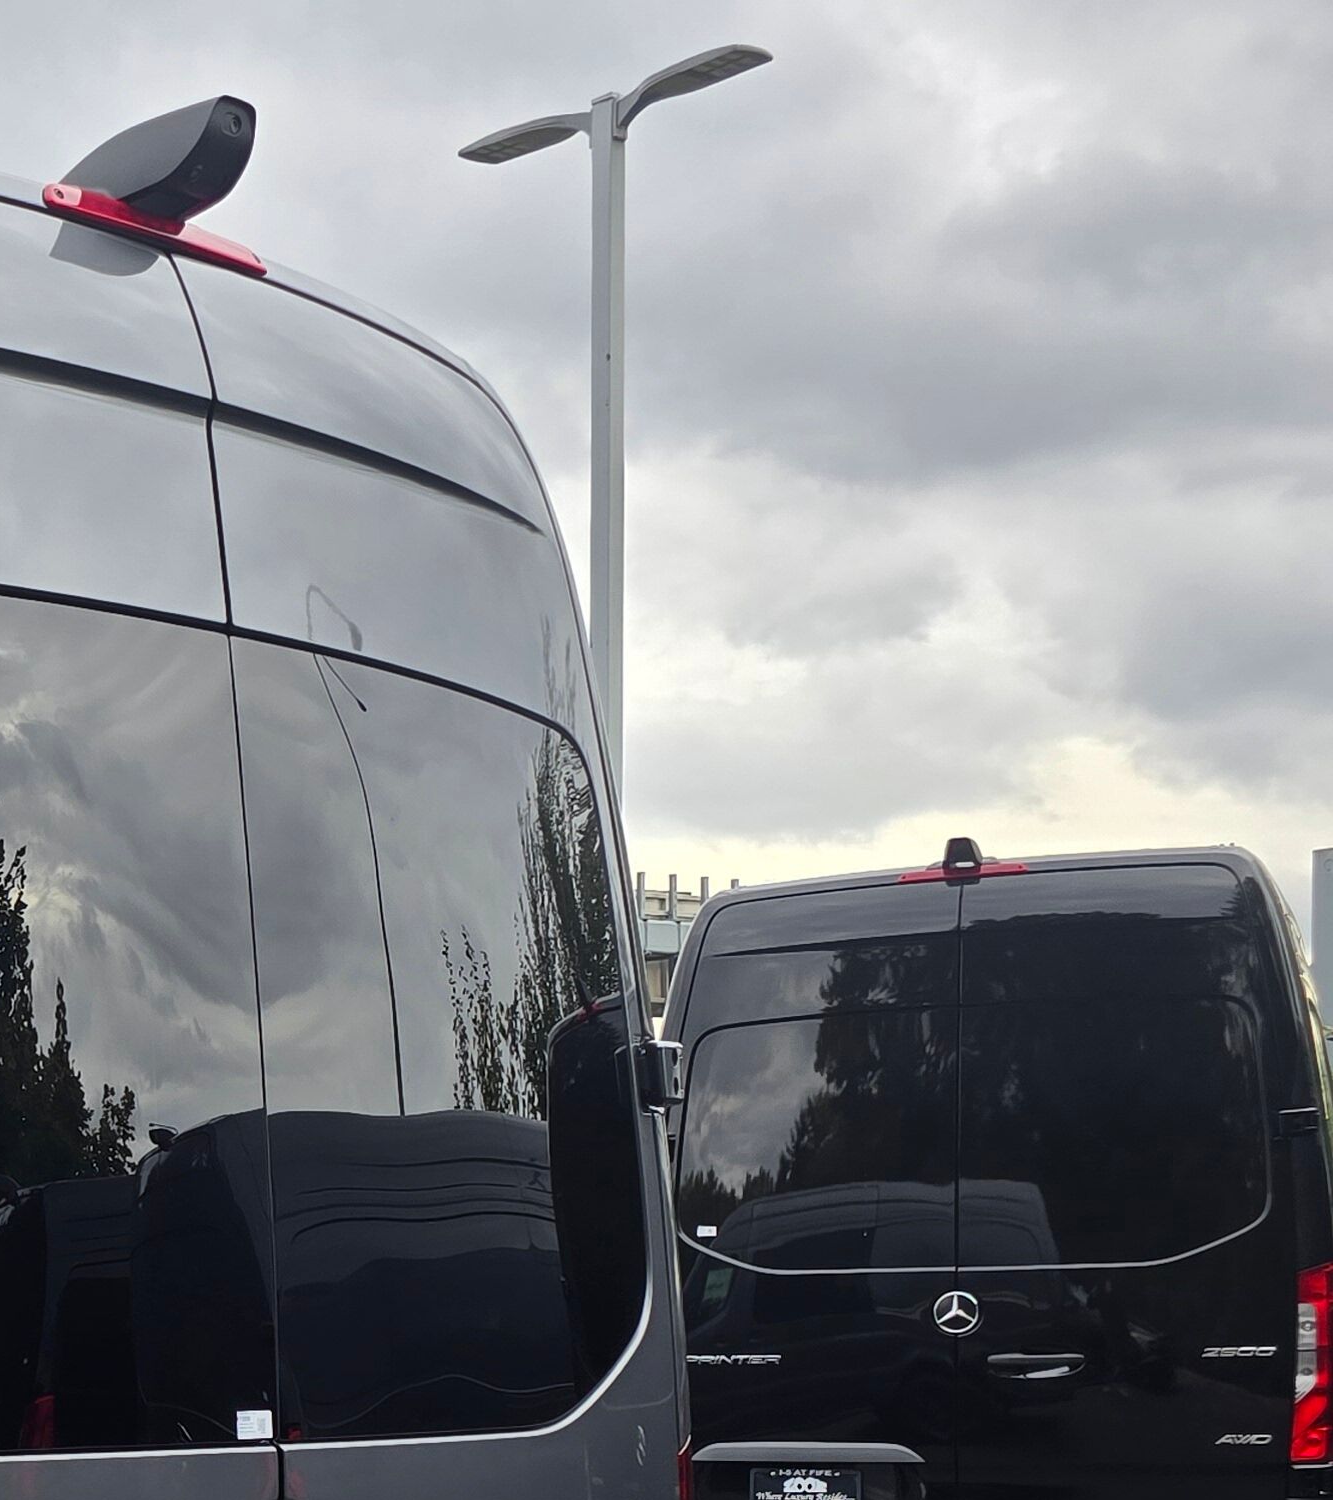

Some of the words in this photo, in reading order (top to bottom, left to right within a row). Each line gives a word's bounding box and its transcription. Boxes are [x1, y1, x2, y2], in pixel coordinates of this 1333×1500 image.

[1201, 1346, 1277, 1358] 2500
[685, 1353, 781, 1365] PRINTER
[1215, 1434, 1273, 1445] AWD
